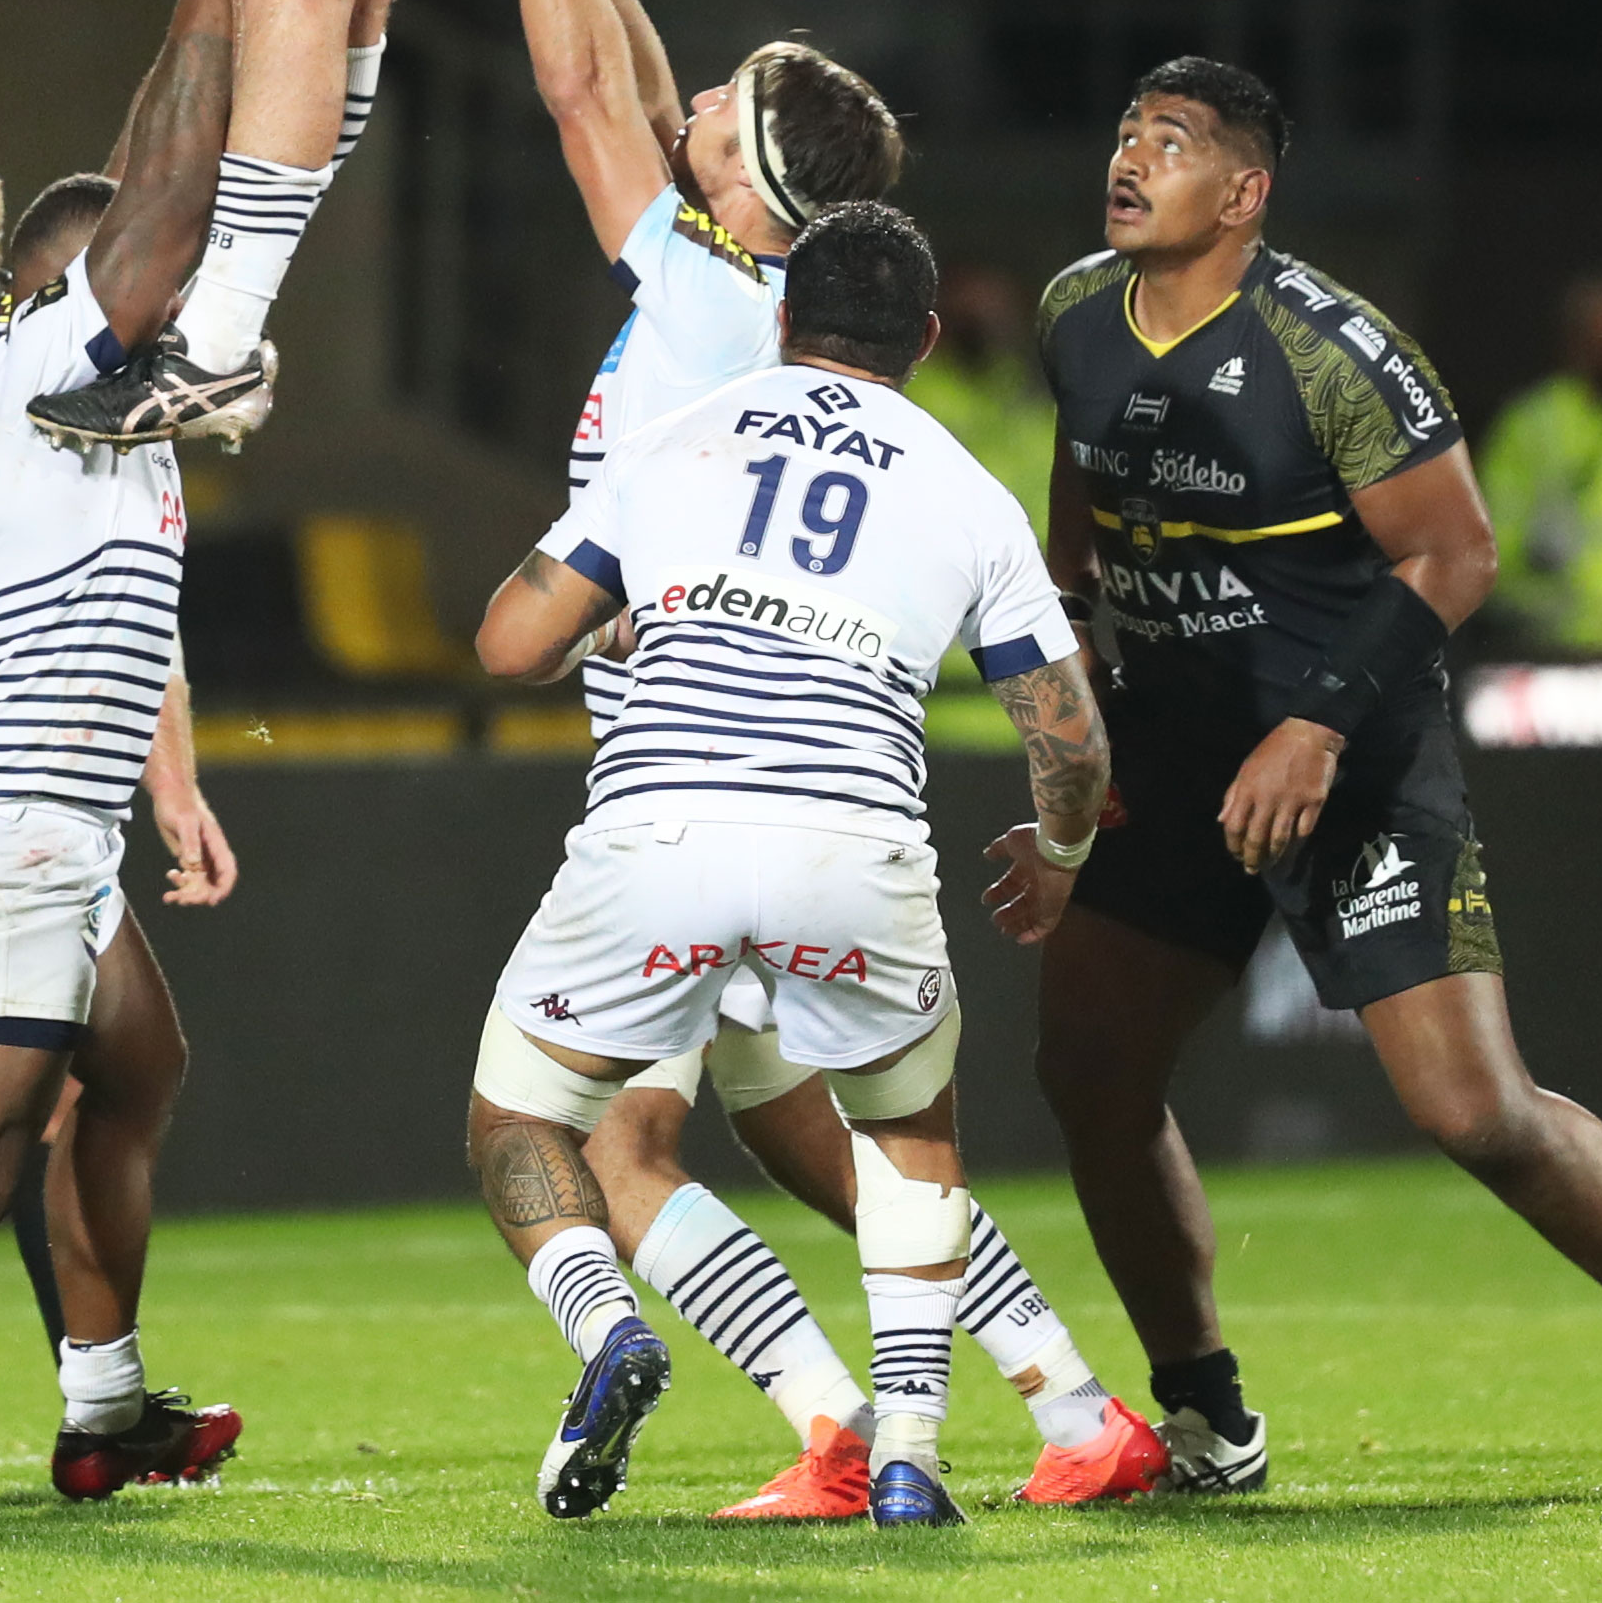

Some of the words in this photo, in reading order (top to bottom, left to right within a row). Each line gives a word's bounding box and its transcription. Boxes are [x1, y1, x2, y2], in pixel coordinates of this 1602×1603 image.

[1350, 315, 1387, 351] AVIA
[1383, 354, 1443, 429] picoty
[734, 409, 905, 471] FAYAT
[735, 452, 871, 577] 19
[1101, 564, 1254, 605] APIVIA
[662, 573, 881, 658] edenauto
[1178, 603, 1268, 638] Macif
[1332, 879, 1349, 897] La
[1337, 880, 1419, 918] Charente
[1342, 900, 1422, 940] Maritime
[642, 936, 867, 983] ARKEA
